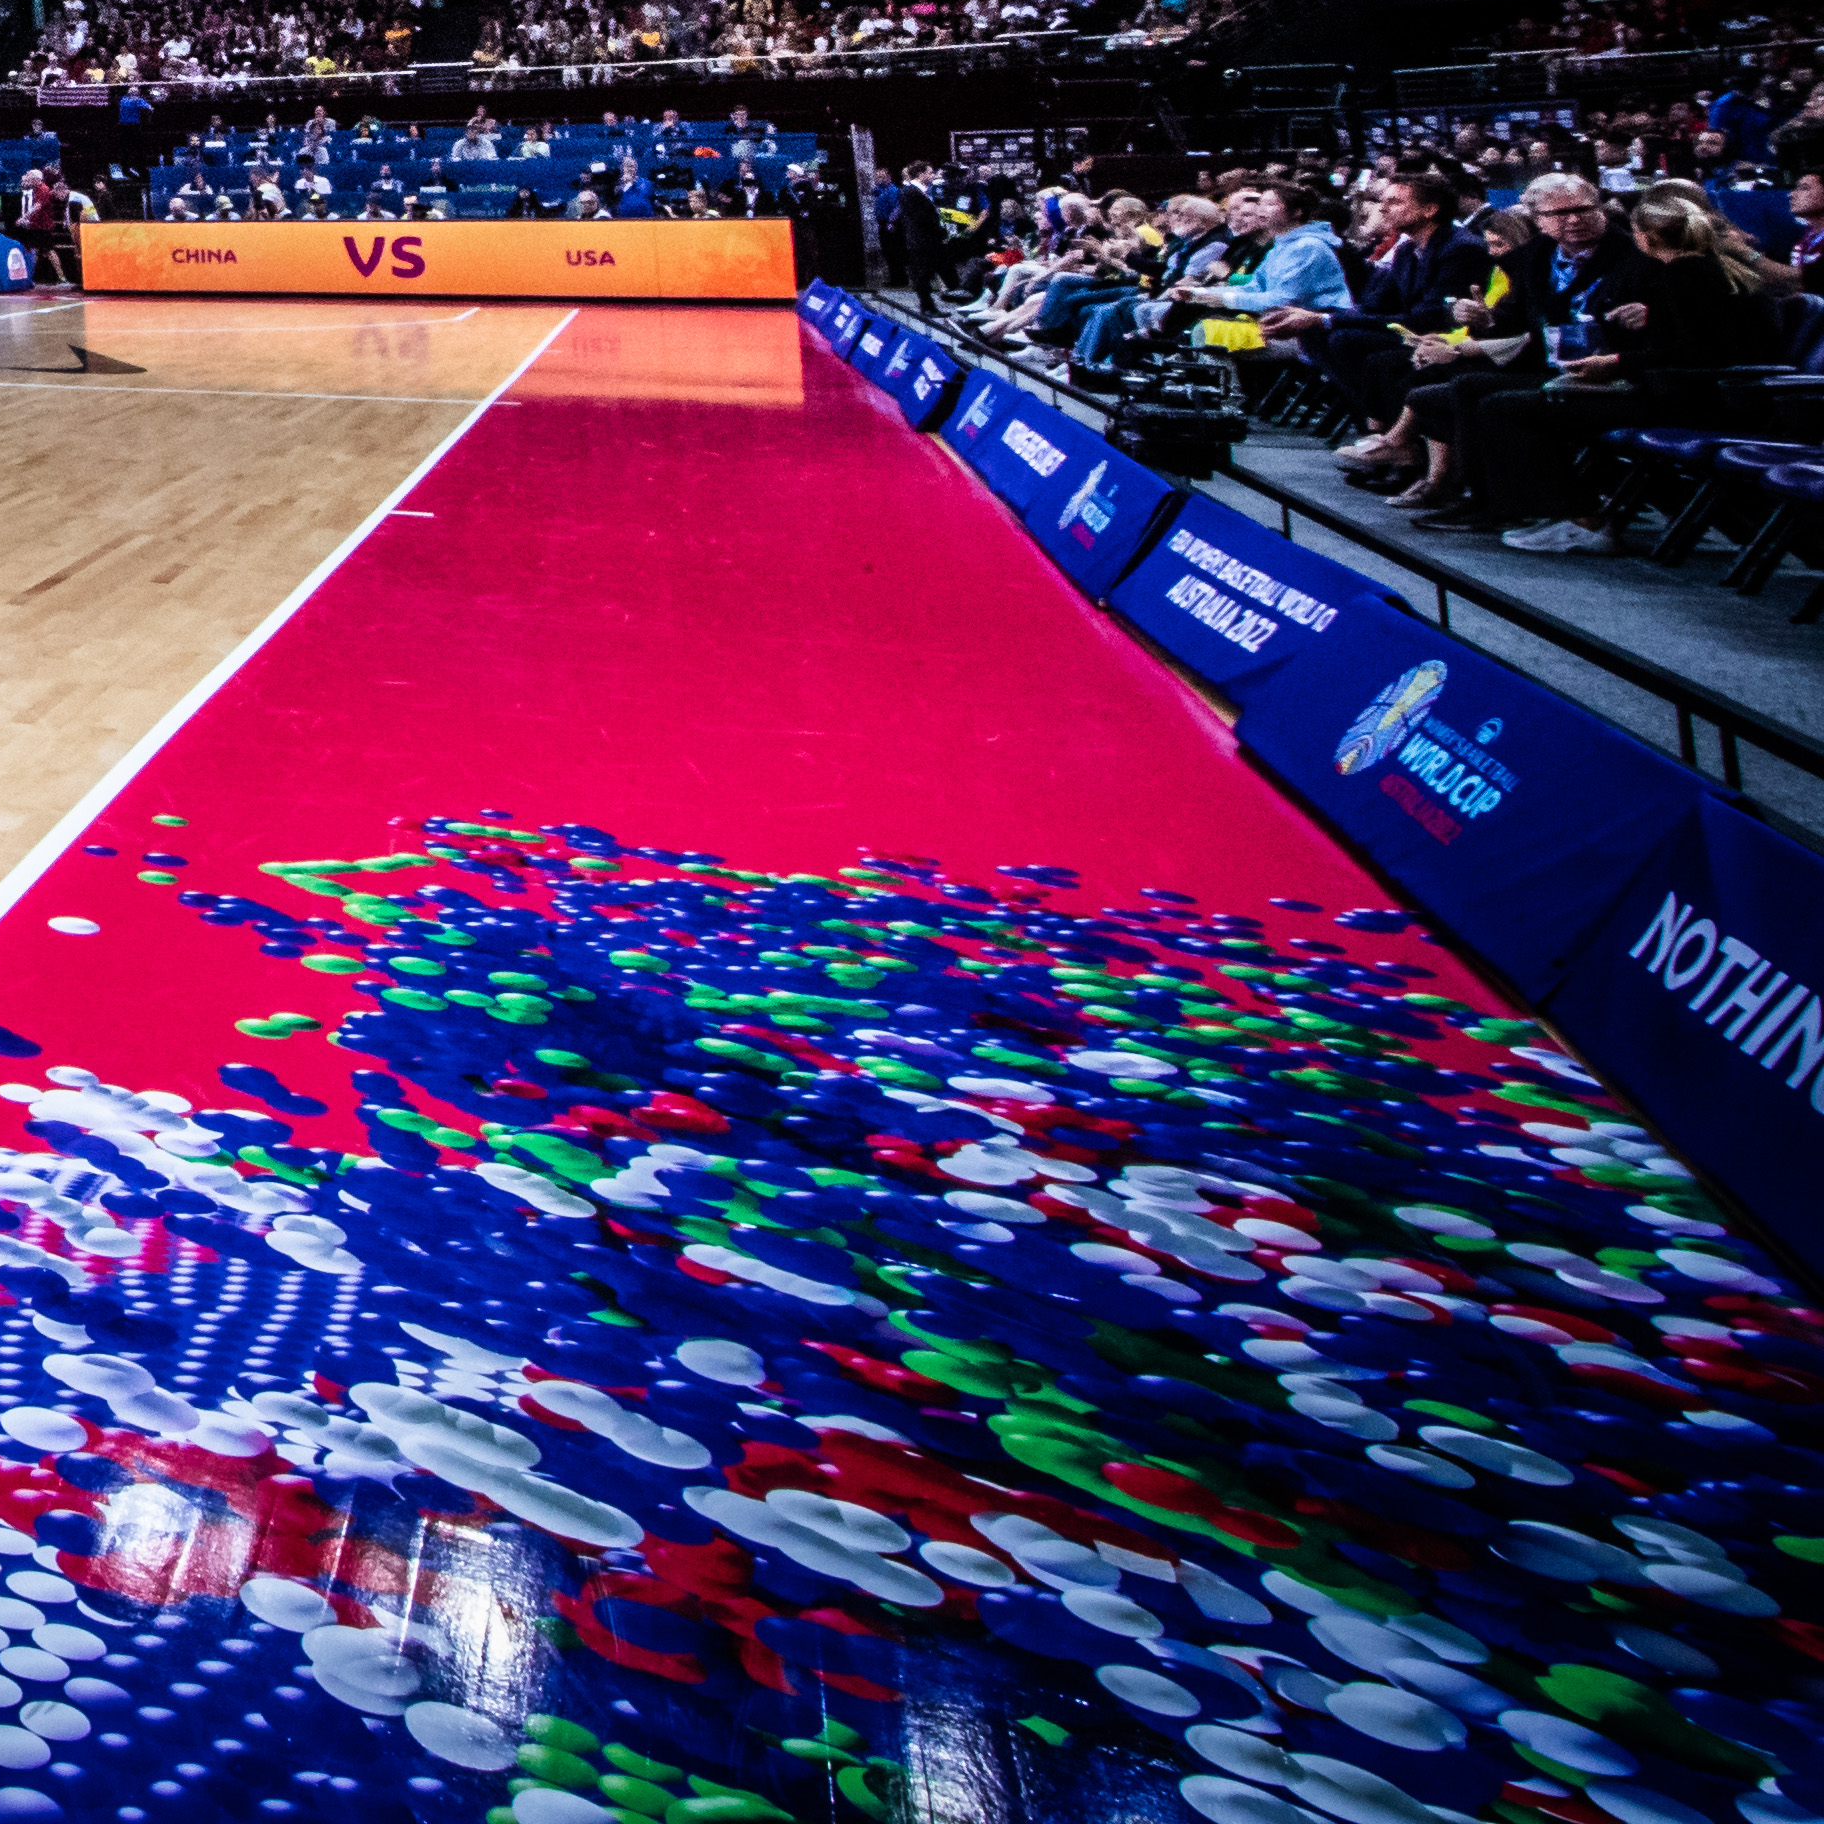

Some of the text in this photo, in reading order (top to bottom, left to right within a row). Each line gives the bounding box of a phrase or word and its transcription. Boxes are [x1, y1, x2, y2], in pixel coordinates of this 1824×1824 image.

[171, 236, 616, 278] CHINA VS USA
[1230, 608, 1280, 654] 2022
[1397, 733, 1502, 820] WORLD CUP
[1629, 890, 1824, 1118] NOTHIN
